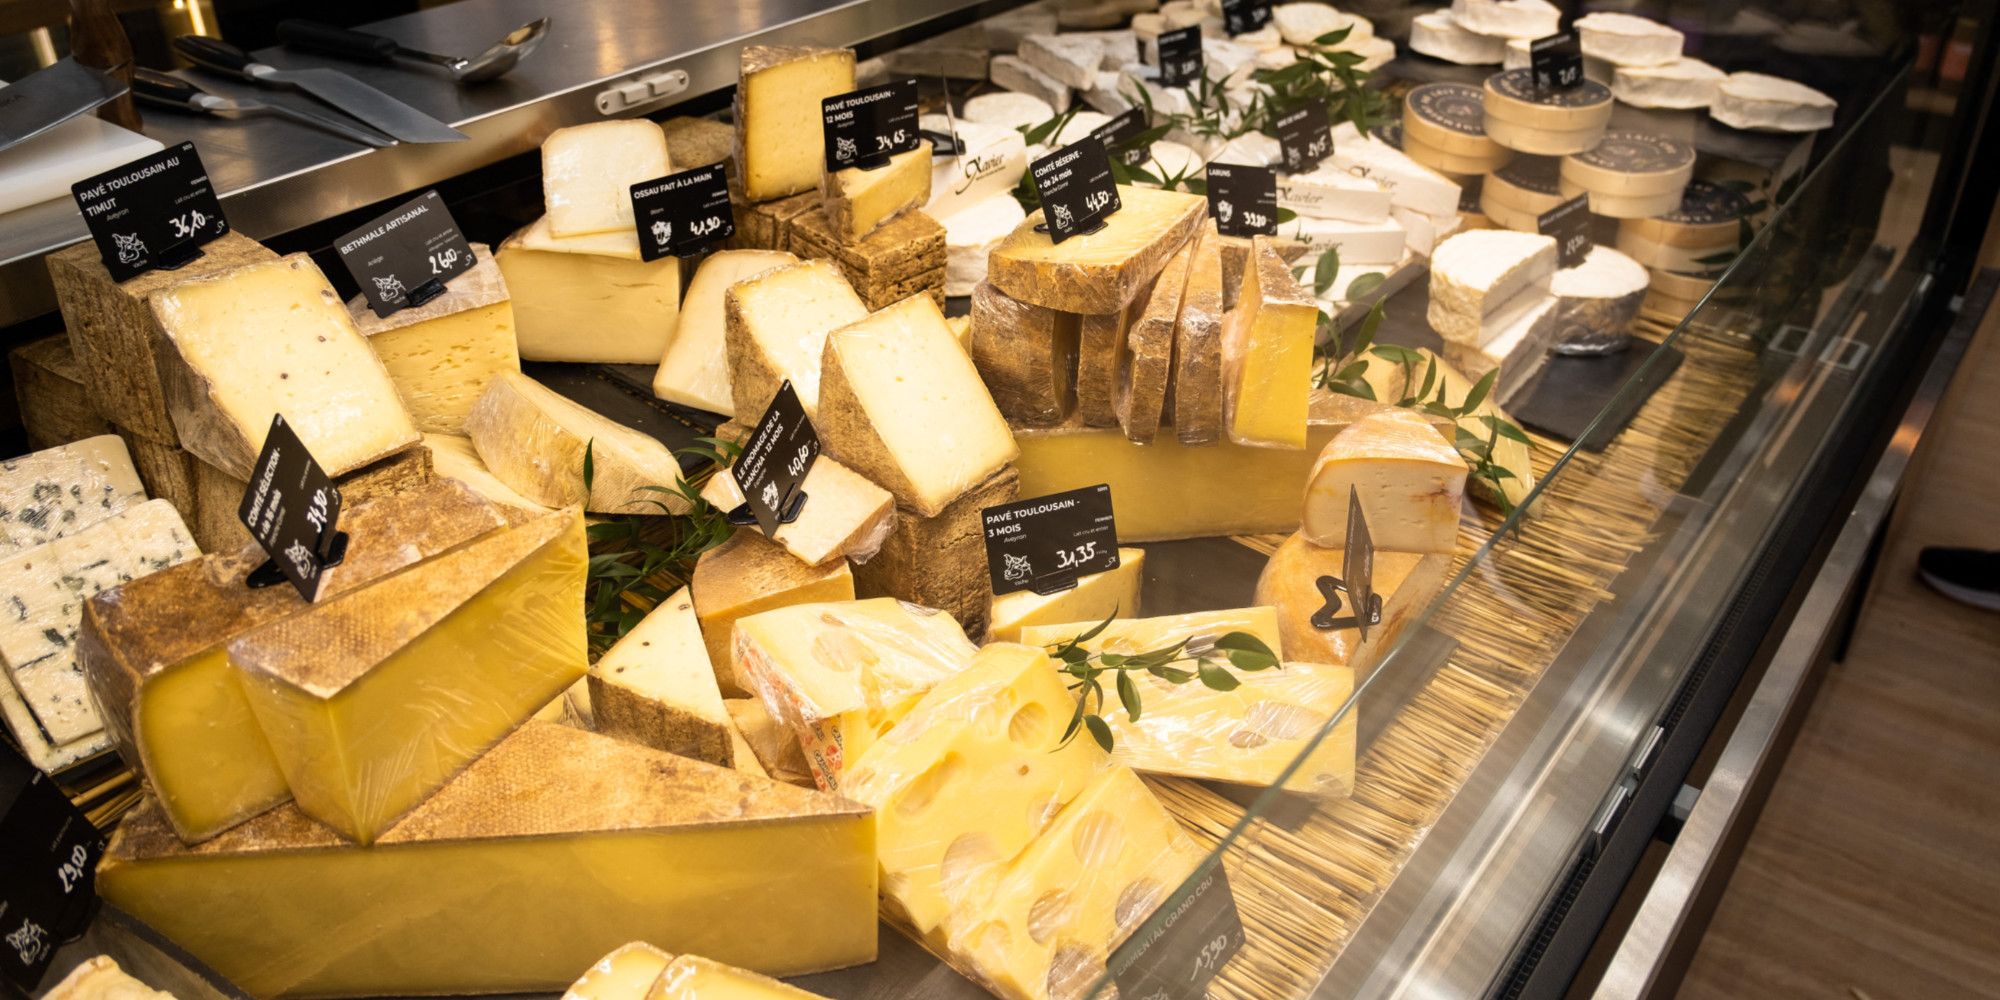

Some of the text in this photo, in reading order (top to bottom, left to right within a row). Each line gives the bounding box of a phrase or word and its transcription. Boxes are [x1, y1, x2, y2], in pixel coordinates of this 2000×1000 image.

[825, 101, 844, 112] PAVÉ
[845, 91, 891, 108] TOULOUSAIN
[825, 110, 854, 124] 12 MOIS
[875, 129, 905, 150] 34,65
[1034, 161, 1056, 178] COMTÉ
[1055, 150, 1080, 169] RÉSERVE
[1208, 168, 1231, 177] LARUNS
[80, 157, 180, 202] PAVÉ TOULOUSAIN AU
[633, 173, 712, 199] OSSAU FAIT À LA MAIN
[1043, 179, 1051, 188] de
[1051, 174, 1059, 184] 24
[1058, 168, 1073, 180] mois
[86, 198, 117, 217] TIMUT
[340, 204, 429, 255] BETHMALE ARTISANAL
[737, 410, 781, 480] LE FROMAGE DE LA
[742, 456, 765, 491] MANCHA
[765, 443, 773, 453] 12
[770, 424, 784, 445] MOIS
[247, 490, 263, 527] COMTÉ
[258, 449, 281, 496] SÉLECTION
[269, 488, 282, 512] mois
[986, 510, 1012, 525] PAVÉ
[1013, 499, 1075, 519] TOULOUSAIN
[988, 523, 1022, 538] 3 MOIS
[1164, 894, 1196, 928] GRAND
[1195, 875, 1214, 897] CRU
[1190, 934, 1228, 982] 15,90
